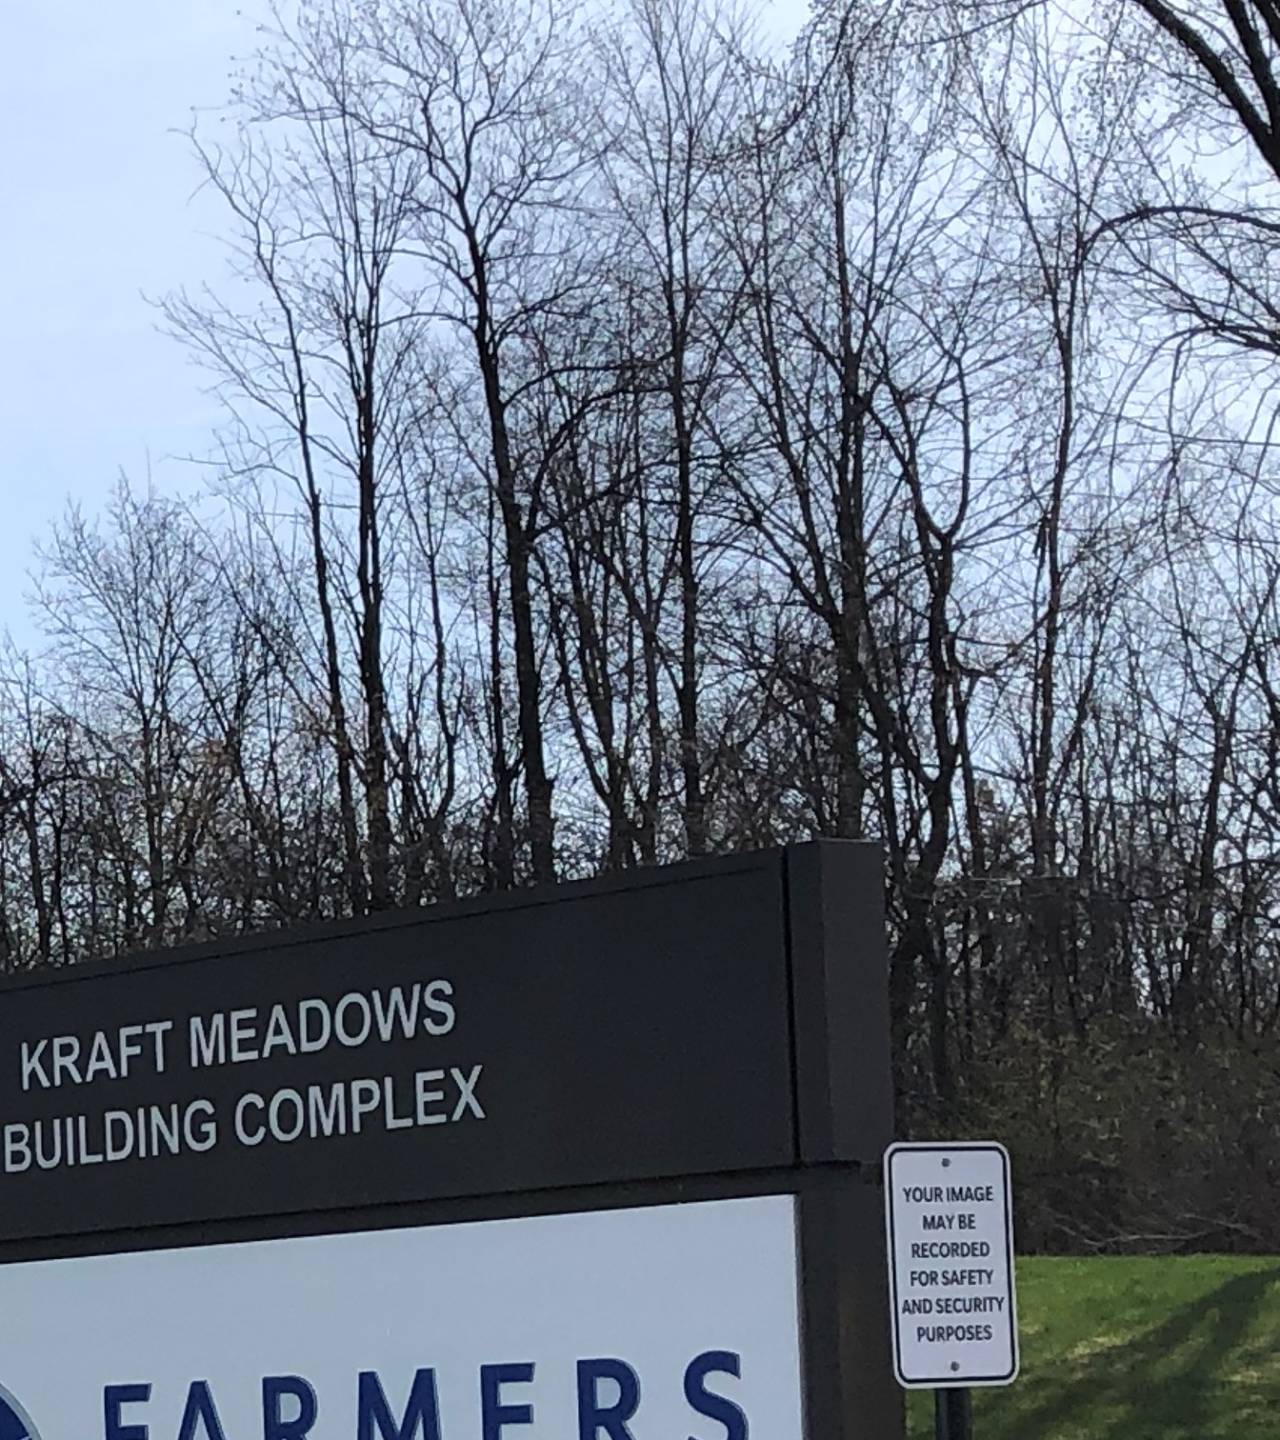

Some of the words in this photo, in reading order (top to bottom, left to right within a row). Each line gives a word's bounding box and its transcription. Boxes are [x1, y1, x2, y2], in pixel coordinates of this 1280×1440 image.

[21, 1021, 173, 1090] KRAFT
[190, 980, 456, 1067] MEADOWS
[4, 1099, 217, 1172] BUILDING
[235, 1065, 486, 1145] COMPLEX
[902, 1186, 943, 1203] YOUR
[946, 1185, 994, 1202] IMAGE
[922, 1214, 955, 1230] MAY
[958, 1213, 976, 1230] BE
[911, 1241, 990, 1258] RECORDED
[910, 1270, 939, 1287] FOR
[941, 1269, 994, 1286] SAFETY
[901, 1298, 933, 1315] AND
[936, 1296, 1004, 1314] SECURITY
[916, 1325, 992, 1342] PURPOSES
